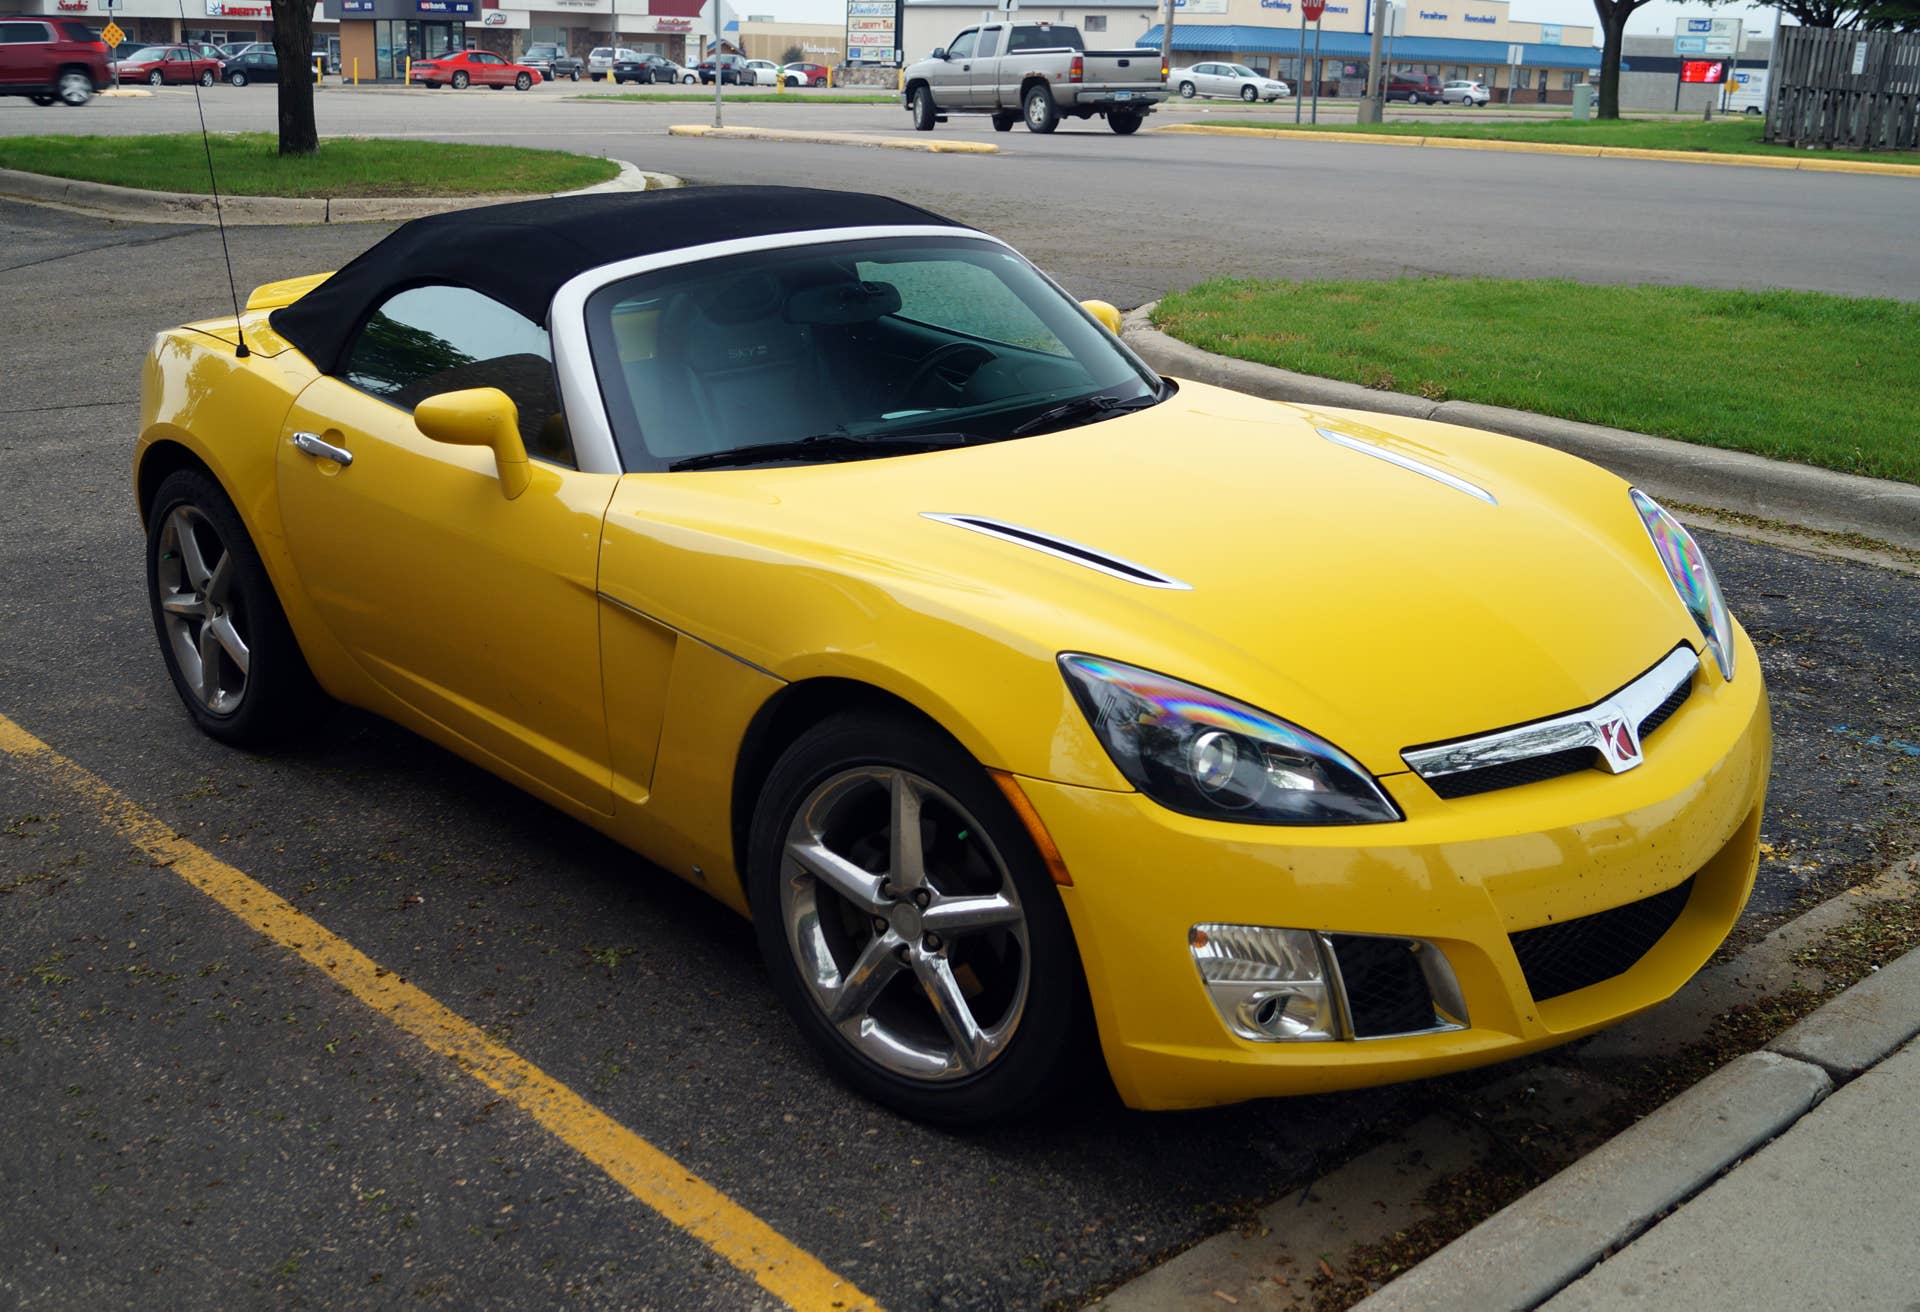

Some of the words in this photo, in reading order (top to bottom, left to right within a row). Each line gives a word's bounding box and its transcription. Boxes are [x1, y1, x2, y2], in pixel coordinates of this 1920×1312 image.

[1261, 0, 1292, 12] Clothing
[1419, 10, 1448, 21] Furniture
[1464, 13, 1497, 24] Household
